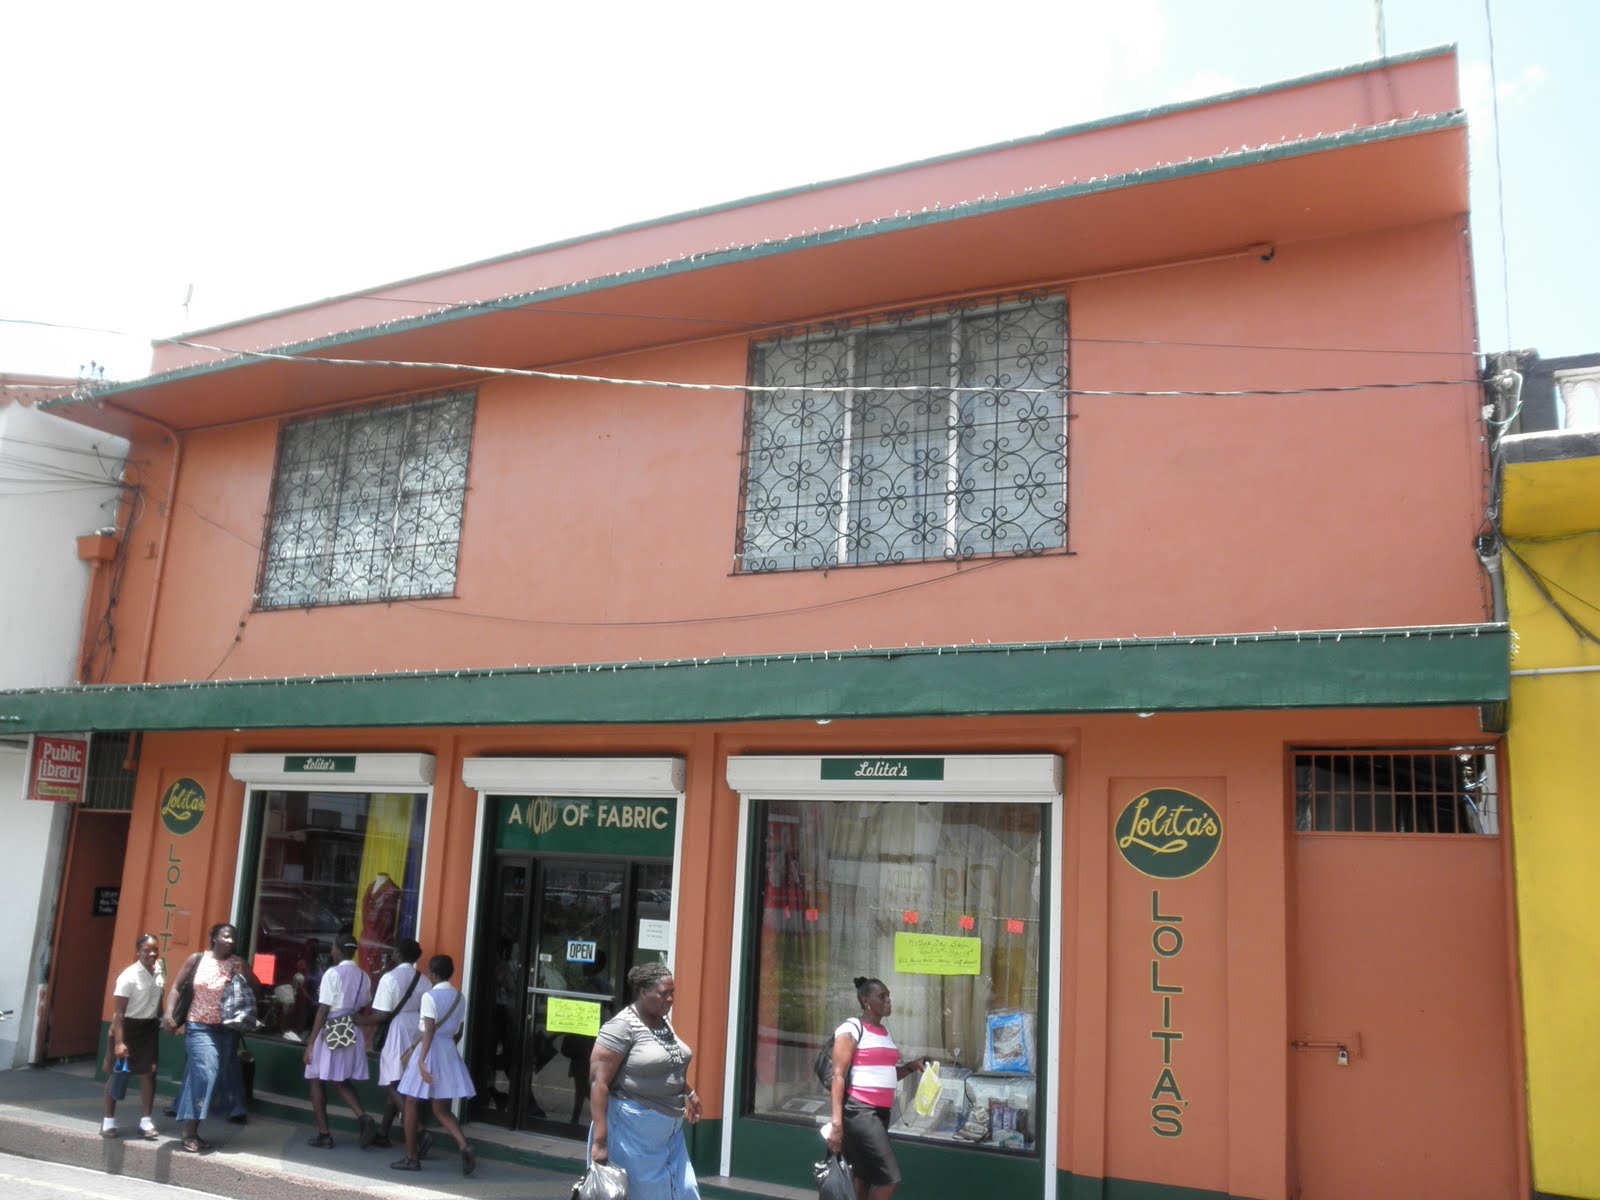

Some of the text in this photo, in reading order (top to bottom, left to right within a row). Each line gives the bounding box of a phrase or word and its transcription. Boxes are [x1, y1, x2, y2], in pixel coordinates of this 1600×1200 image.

[43, 743, 82, 763] Public
[303, 757, 335, 770] Lolita's
[854, 761, 908, 777] Lolita's
[508, 796, 669, 835] A WORLD OF FABRIC
[1119, 797, 1219, 855] Lolita's
[569, 943, 594, 960] OPEN
[1151, 889, 1190, 1138] LOLITA'S
